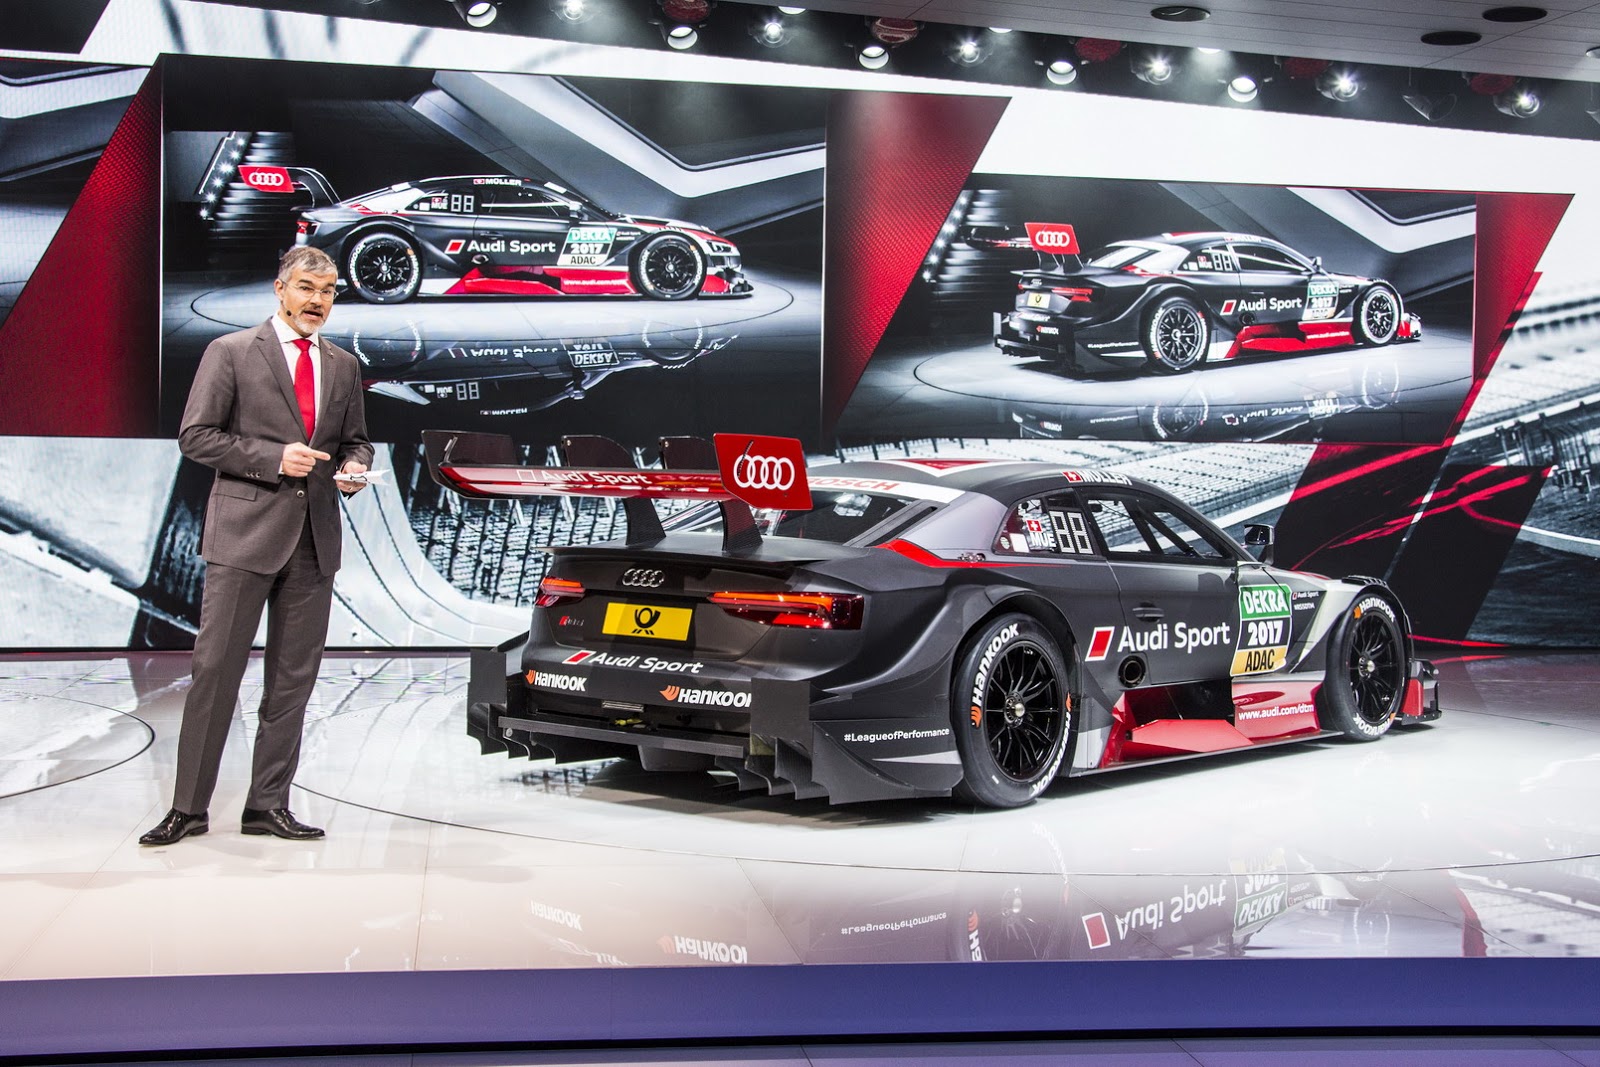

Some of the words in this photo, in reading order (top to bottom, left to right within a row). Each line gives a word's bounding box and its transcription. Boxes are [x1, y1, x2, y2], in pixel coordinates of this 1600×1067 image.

[571, 229, 611, 241] DEKRA
[467, 240, 505, 253] Audi
[509, 240, 556, 255] Sport
[570, 243, 604, 254] 2017
[570, 256, 596, 265] ADAC
[1238, 298, 1266, 312] Audi
[1269, 297, 1302, 312] Sport
[541, 470, 586, 483] Audi
[590, 471, 652, 485] Sport
[1029, 533, 1057, 548] MUE
[1242, 588, 1289, 614] DEKRA
[1117, 623, 1168, 653] Audi
[1174, 621, 1231, 653] Sport
[1247, 620, 1284, 647] 2017
[589, 652, 641, 668] Audi
[639, 657, 704, 674] Sport
[1245, 649, 1275, 672] ADAC
[1238, 703, 1314, 720] www.audi.com/dtm
[844, 728, 950, 743] #LeagueofPerformance
